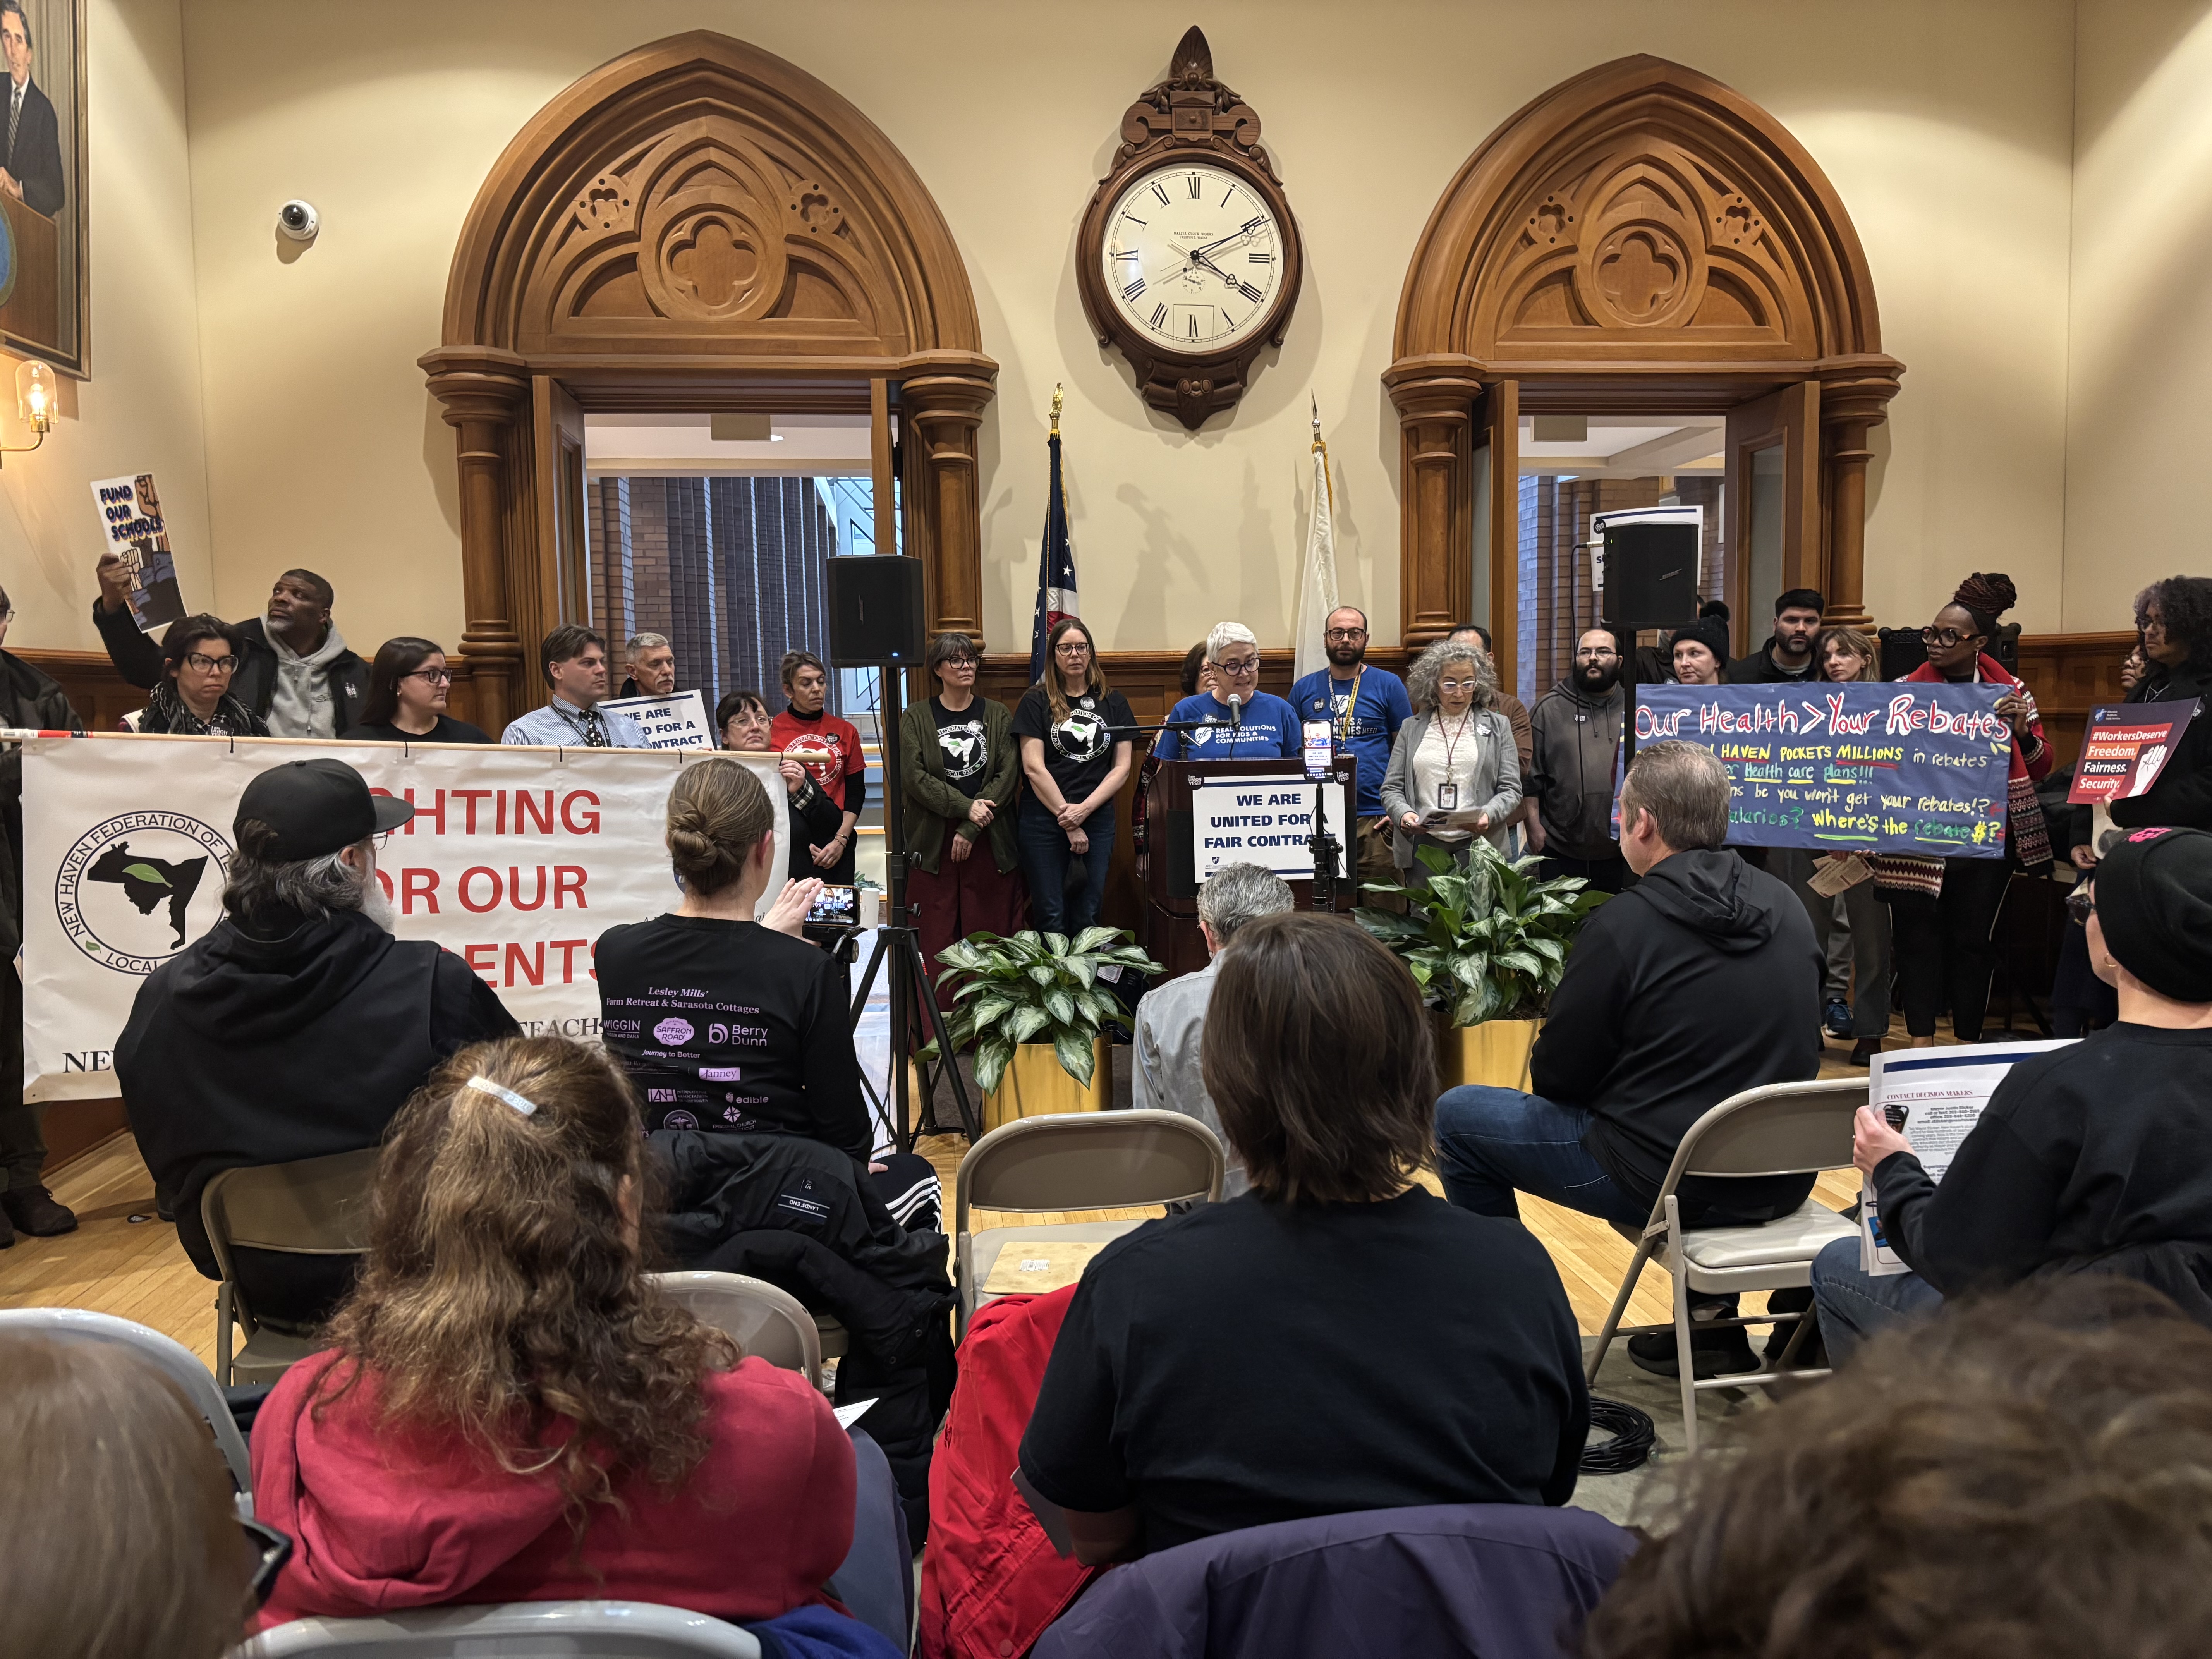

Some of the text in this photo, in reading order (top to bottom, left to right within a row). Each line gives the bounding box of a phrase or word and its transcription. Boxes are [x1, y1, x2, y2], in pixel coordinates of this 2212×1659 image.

[1185, 177, 1202, 199] XII
[1149, 184, 1171, 208] XI
[1249, 252, 1270, 265] III
[1187, 314, 1201, 337] VI
[100, 485, 134, 505] FUND
[106, 505, 132, 523] OUR
[111, 517, 165, 541] SCHOOLS
[646, 708, 672, 719] ARE
[1635, 705, 1692, 739] Our
[1700, 699, 1798, 735] Health
[1826, 692, 1880, 737] Your
[1886, 694, 2012, 741] Rebates
[656, 722, 682, 733] FOR
[686, 721, 696, 729] A
[650, 735, 703, 749] NTRACT
[2092, 730, 2167, 741] #WorkersDeserve
[978, 733, 987, 762] TEACHERS
[1721, 742, 1987, 767] HAVEN POCKETS MILLIONS in rebates
[2088, 745, 2136, 756] Freedom.
[1745, 762, 1782, 778] Health
[1788, 765, 1814, 779] care
[2083, 762, 2127, 773] Fairness.
[2079, 778, 2120, 789] Security.
[1237, 793, 1301, 806] WE ARE
[1755, 783, 1768, 798] bc
[1778, 788, 1799, 803] you
[1844, 792, 1872, 812] get
[1880, 794, 1911, 810] your
[1211, 814, 1311, 827] UNITED FOR
[1729, 807, 1804, 830] alaries?
[1882, 816, 1908, 835] the
[1915, 817, 1970, 839] rebate
[90, 814, 223, 848] FEDERATION OF
[1204, 834, 1335, 848] FAIR CONTRA
[61, 843, 93, 937] NEW HAVEN
[458, 866, 588, 912] OUR
[648, 987, 679, 998] Lesley
[606, 998, 623, 1006] Farm
[626, 998, 659, 1006] Retreat
[671, 999, 713, 1010] Sarasota
[716, 1002, 759, 1014] Cottages
[518, 1017, 603, 1038] EACH
[604, 1019, 641, 1031] WIGGIN
[656, 1026, 692, 1034] SAFFRON
[732, 1024, 768, 1038] Berry
[732, 1035, 767, 1046] Dunn
[642, 1049, 667, 1058] Journey
[62, 1050, 115, 1073] NE
[701, 1069, 736, 1079] Janney
[737, 1119, 756, 1128] CHURCH
